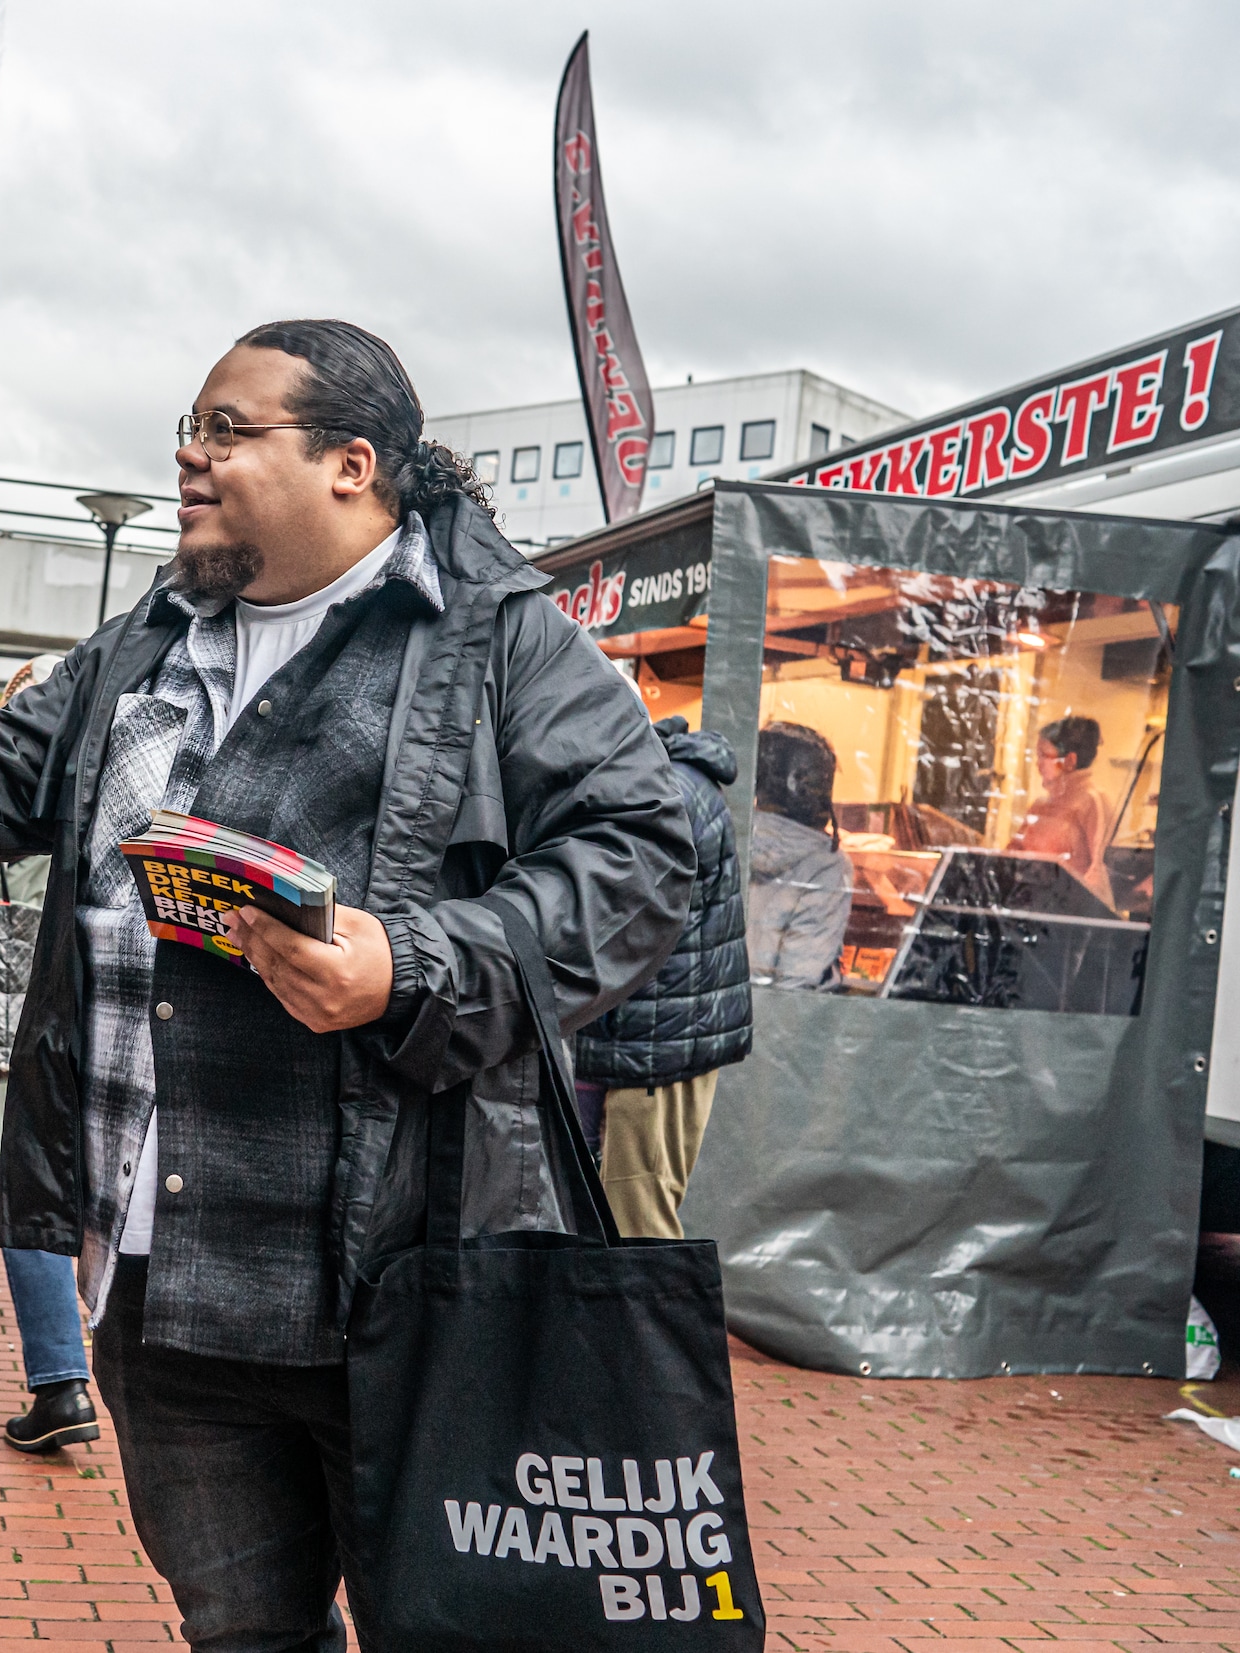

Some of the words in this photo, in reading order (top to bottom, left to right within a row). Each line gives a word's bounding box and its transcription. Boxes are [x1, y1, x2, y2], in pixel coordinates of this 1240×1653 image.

[628, 568, 683, 607] SINDS
[143, 860, 255, 900] BREEK
[147, 872, 192, 892] DE
[515, 1450, 724, 1513] GELIJK
[444, 1499, 732, 1569] WAARDIG
[599, 1571, 744, 1621] BIJ1
